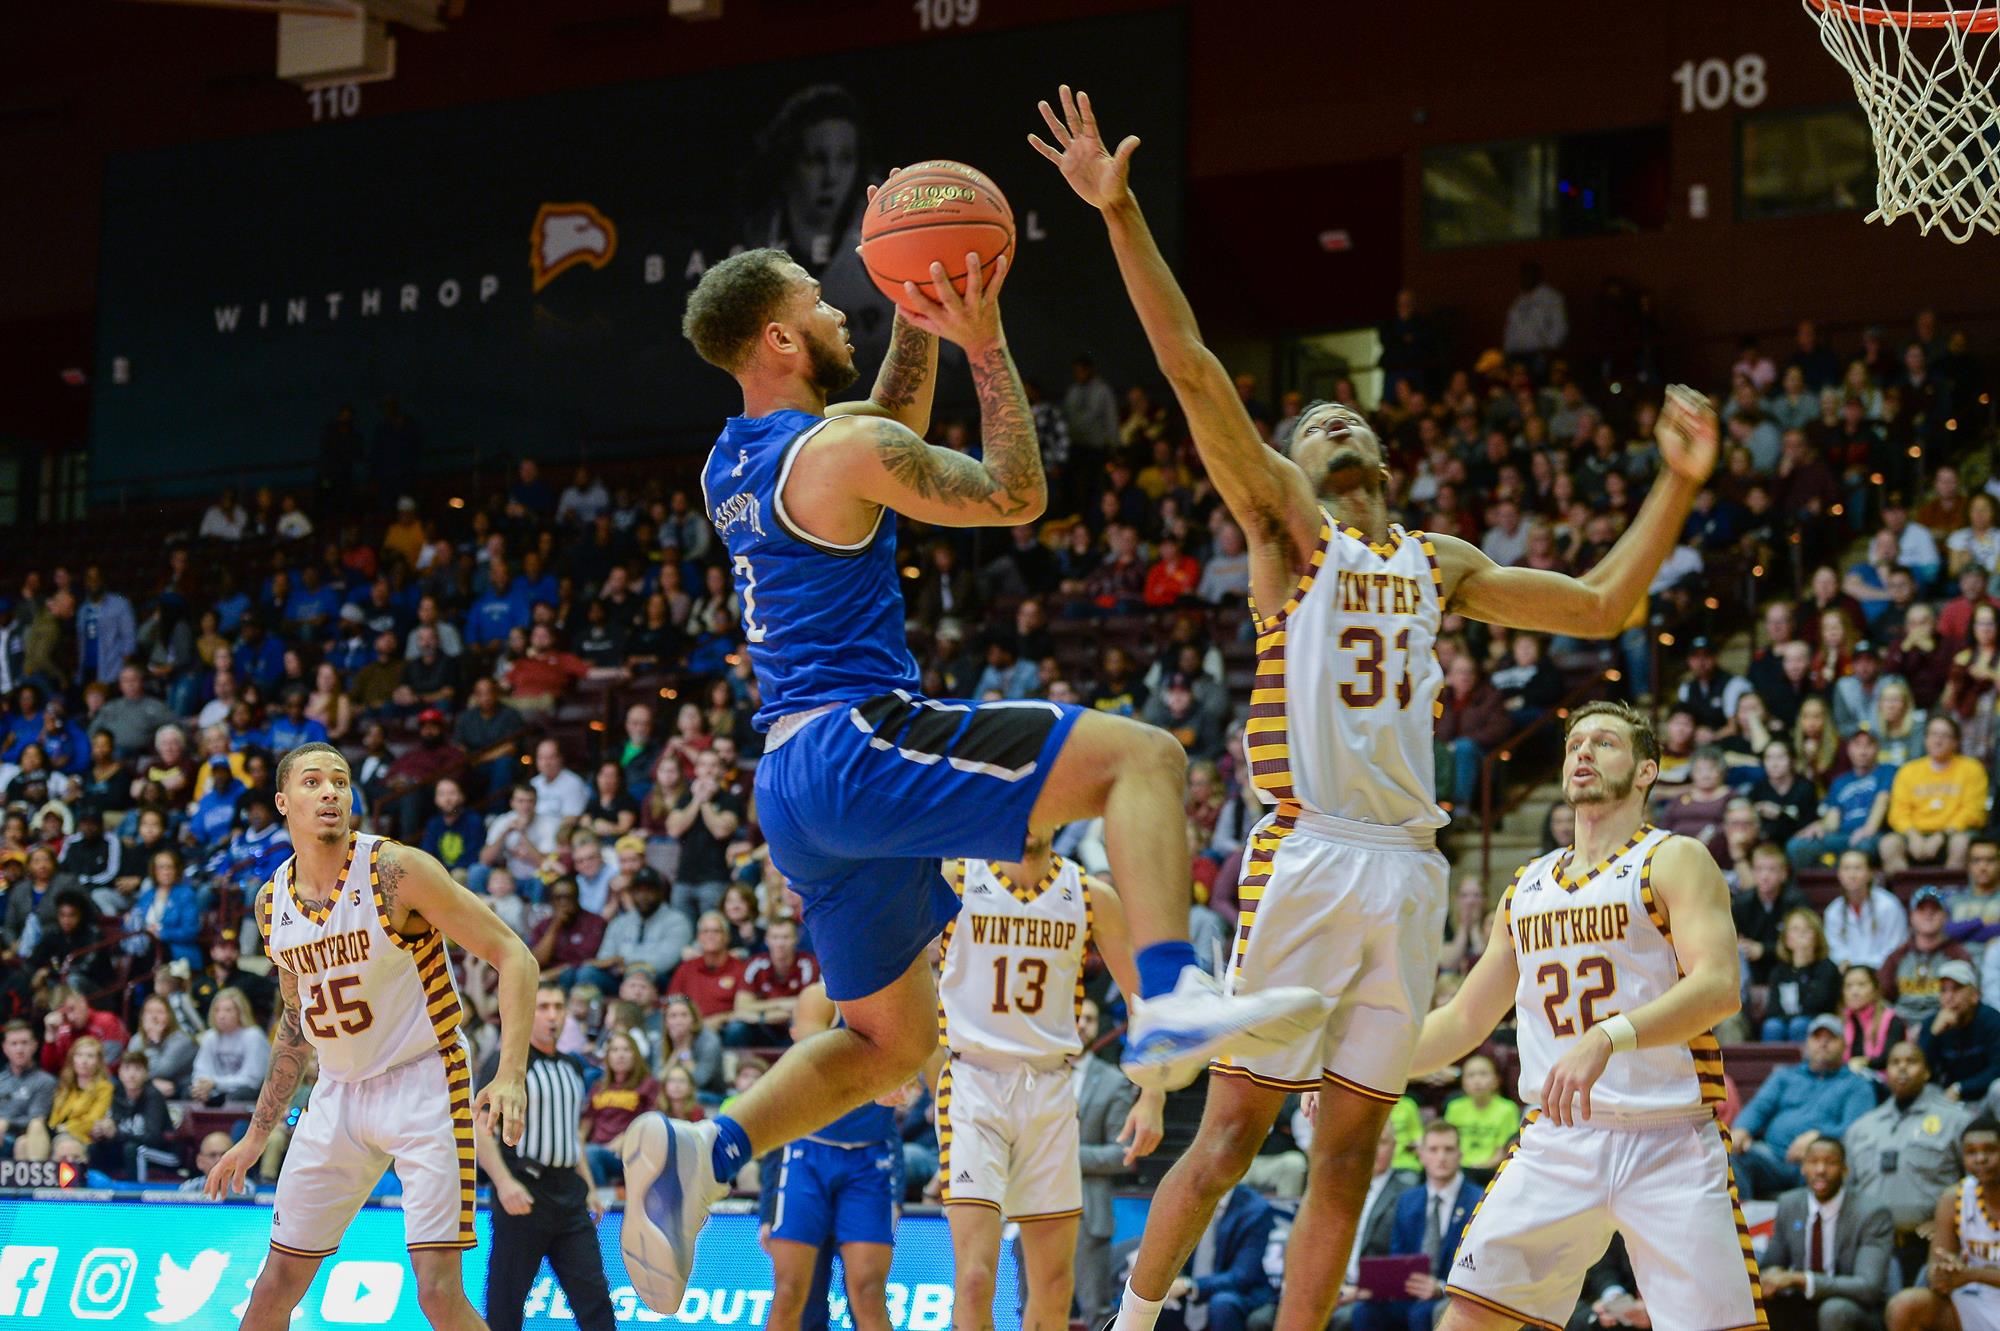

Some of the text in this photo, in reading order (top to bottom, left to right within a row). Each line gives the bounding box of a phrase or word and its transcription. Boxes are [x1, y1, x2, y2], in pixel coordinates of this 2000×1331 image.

[913, 0, 980, 32] 109
[306, 83, 362, 122] 110
[1671, 52, 1769, 114] 108
[213, 273, 500, 333] WINTHROP
[279, 929, 371, 977] WINTHROP
[971, 914, 1077, 950] WINTHROP
[1517, 902, 1630, 955] WINTHROP
[304, 975, 375, 1039] 25
[990, 955, 1049, 1016] 13
[1536, 955, 1620, 1039] 22
